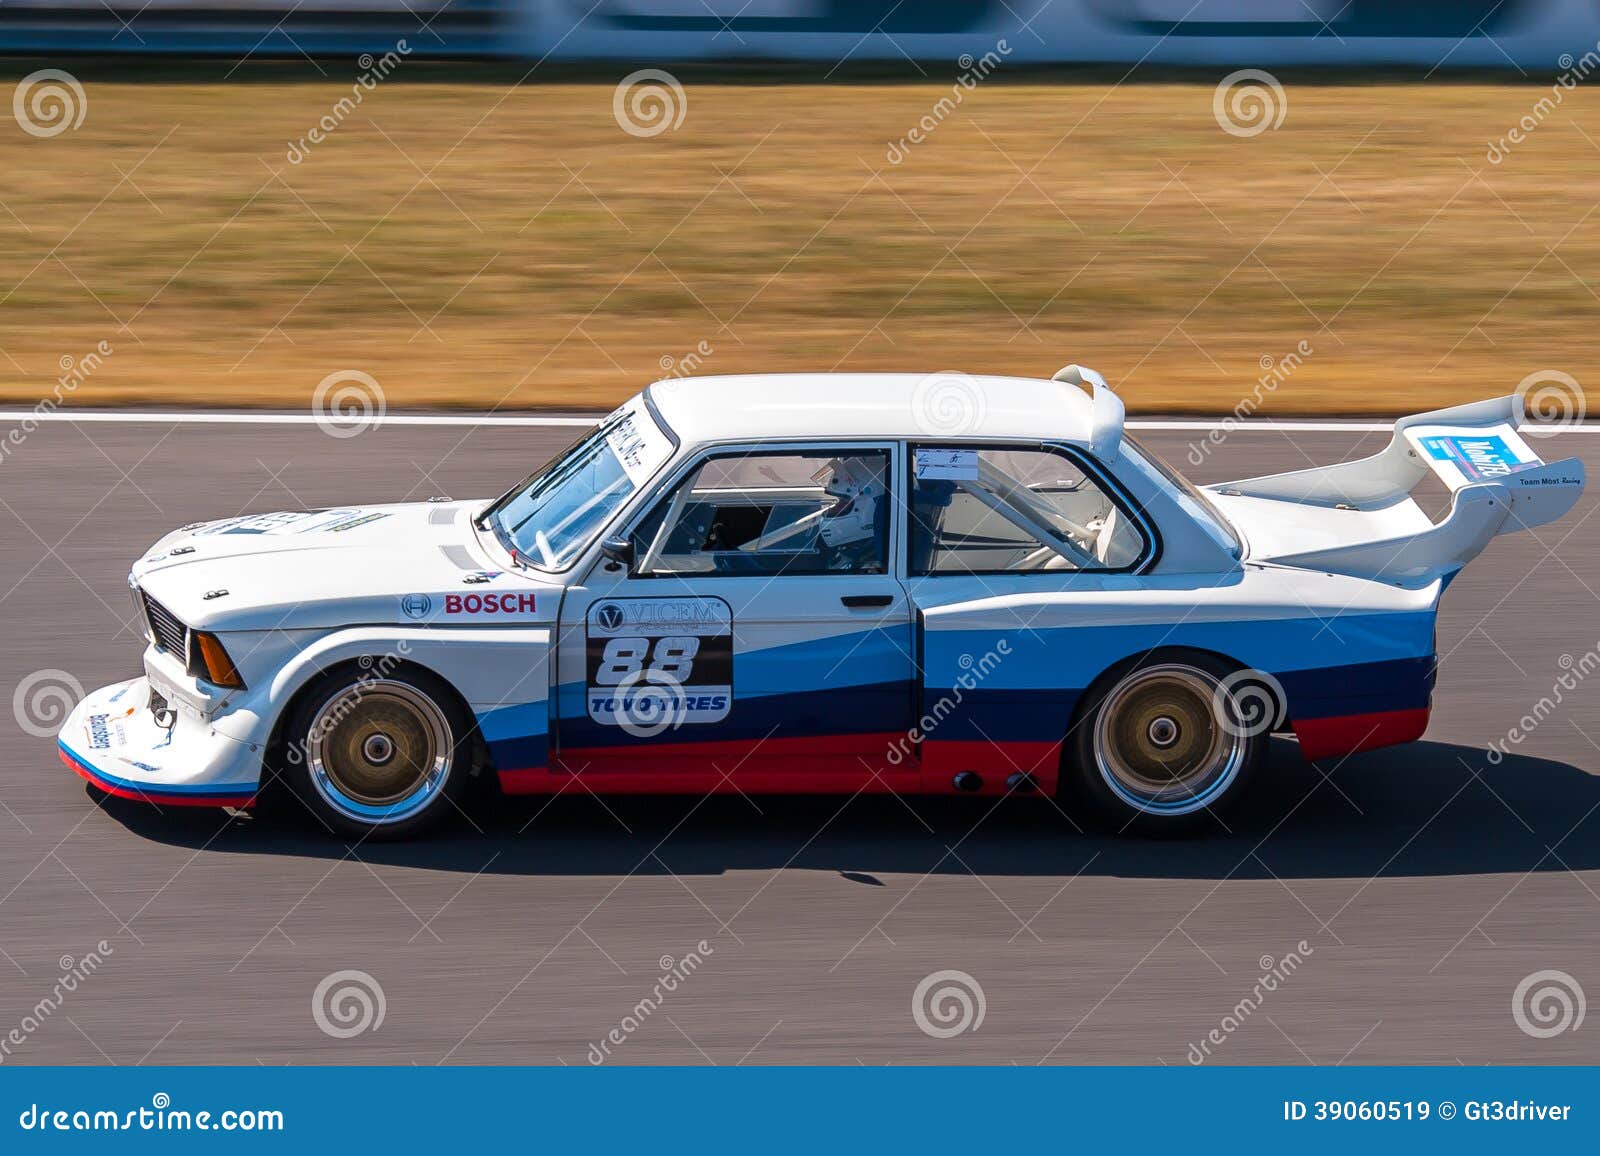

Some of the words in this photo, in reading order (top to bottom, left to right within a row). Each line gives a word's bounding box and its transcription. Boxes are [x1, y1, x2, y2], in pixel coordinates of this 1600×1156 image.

[445, 593, 536, 614] BOSCH
[627, 603, 716, 623] VICEM
[596, 636, 700, 685] 88
[660, 696, 727, 711] TIRES
